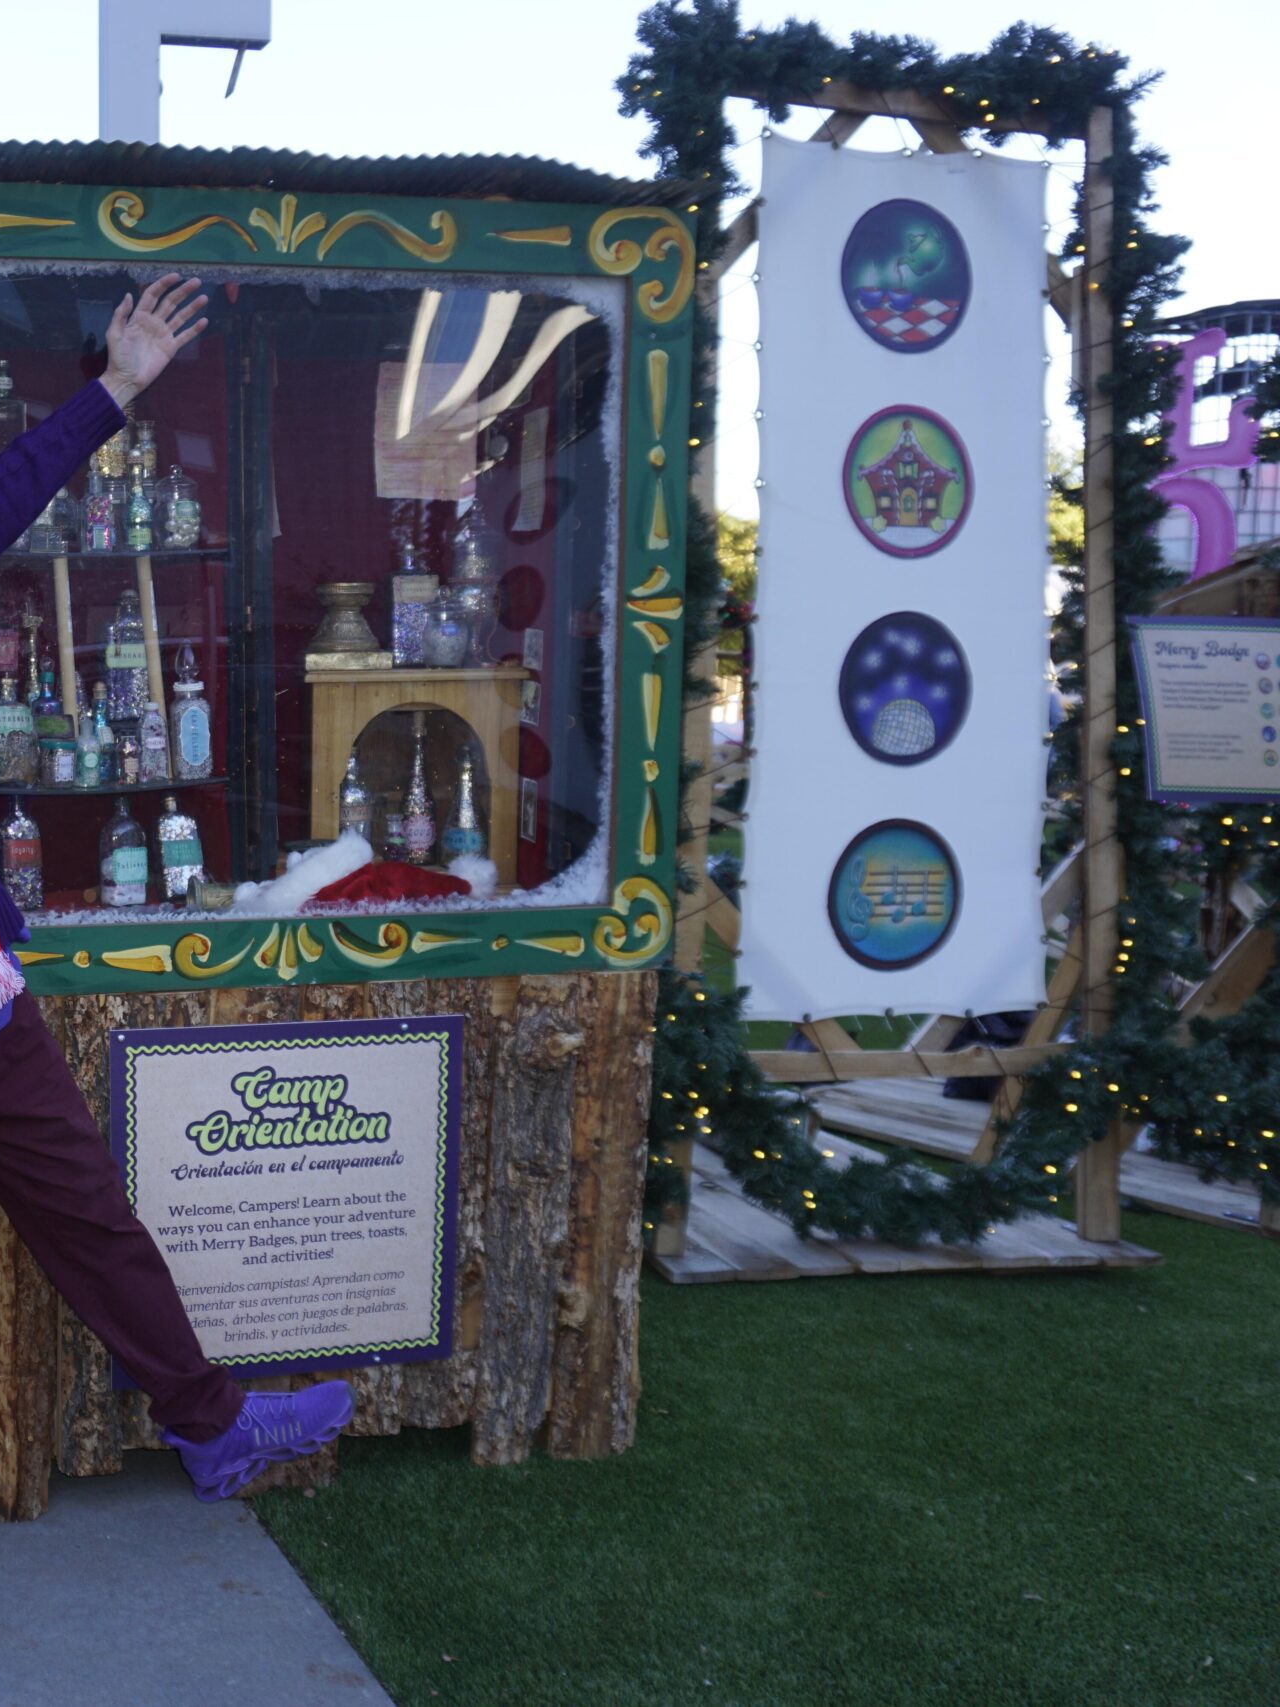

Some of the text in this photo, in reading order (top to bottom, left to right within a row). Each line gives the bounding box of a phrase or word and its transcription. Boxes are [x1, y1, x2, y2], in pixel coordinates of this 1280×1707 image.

[1154, 641, 1200, 660] Merry
[232, 1067, 348, 1117] Camp
[187, 1104, 390, 1154] Orientation
[171, 1150, 405, 1181] Orientación en el campamento
[168, 1190, 407, 1218] Welcome, Campers! Learn about the
[158, 1209, 416, 1237] ways you can enhance your adventure
[165, 1226, 408, 1253] with Merry Badges, pun trees, toasts,
[242, 1247, 334, 1266] and activities!
[247, 1276, 310, 1292] campistas!
[312, 1271, 371, 1287] Aprendan
[373, 1270, 405, 1281] como
[185, 1286, 396, 1313] umentar sus aventuras con insignias
[190, 1316, 228, 1329] deñas,
[232, 1312, 276, 1325] árboles
[278, 1311, 299, 1321] con
[302, 1308, 339, 1321] juegos
[340, 1304, 356, 1316] de
[271, 1329, 279, 1340] y
